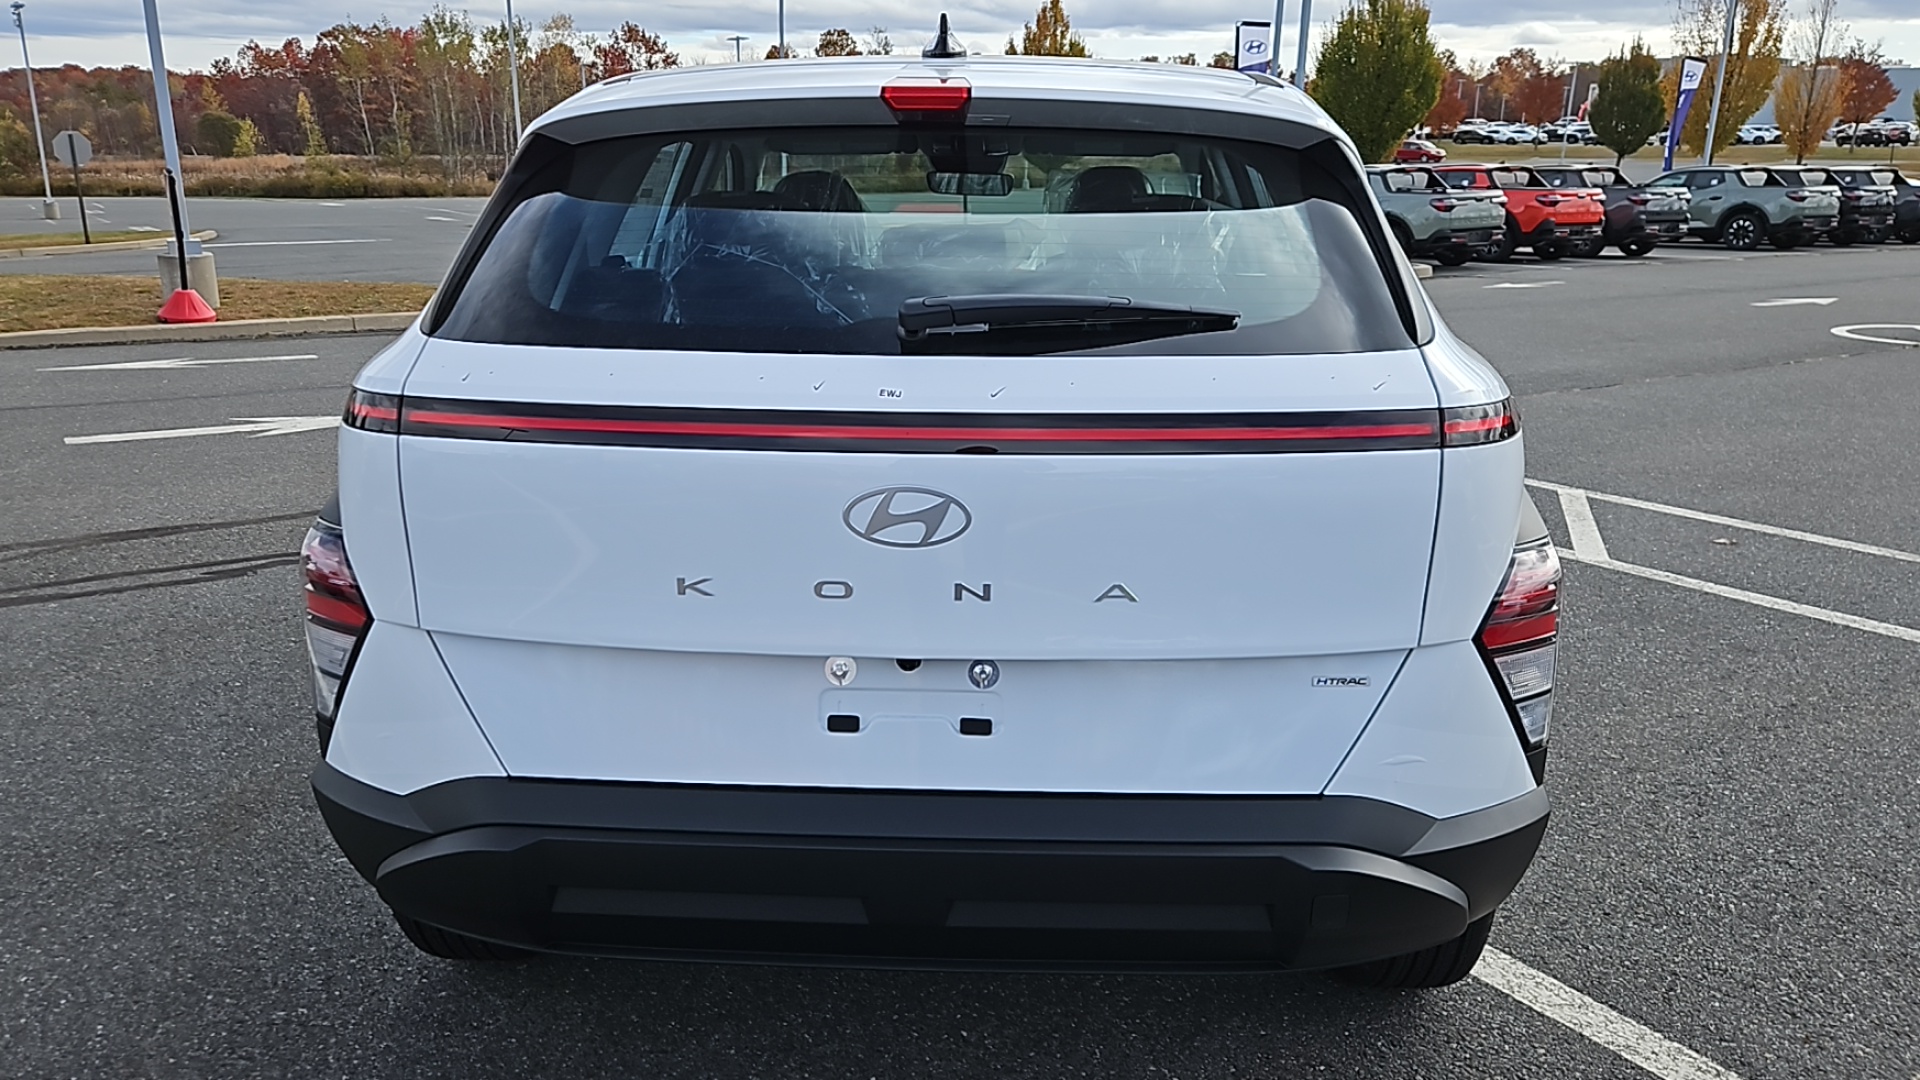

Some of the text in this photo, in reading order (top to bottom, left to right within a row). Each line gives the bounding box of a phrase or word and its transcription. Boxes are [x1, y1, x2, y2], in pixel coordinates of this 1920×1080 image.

[879, 388, 902, 398] EWJ
[676, 577, 1138, 603] KONA
[1316, 677, 1367, 686] HTRAC
